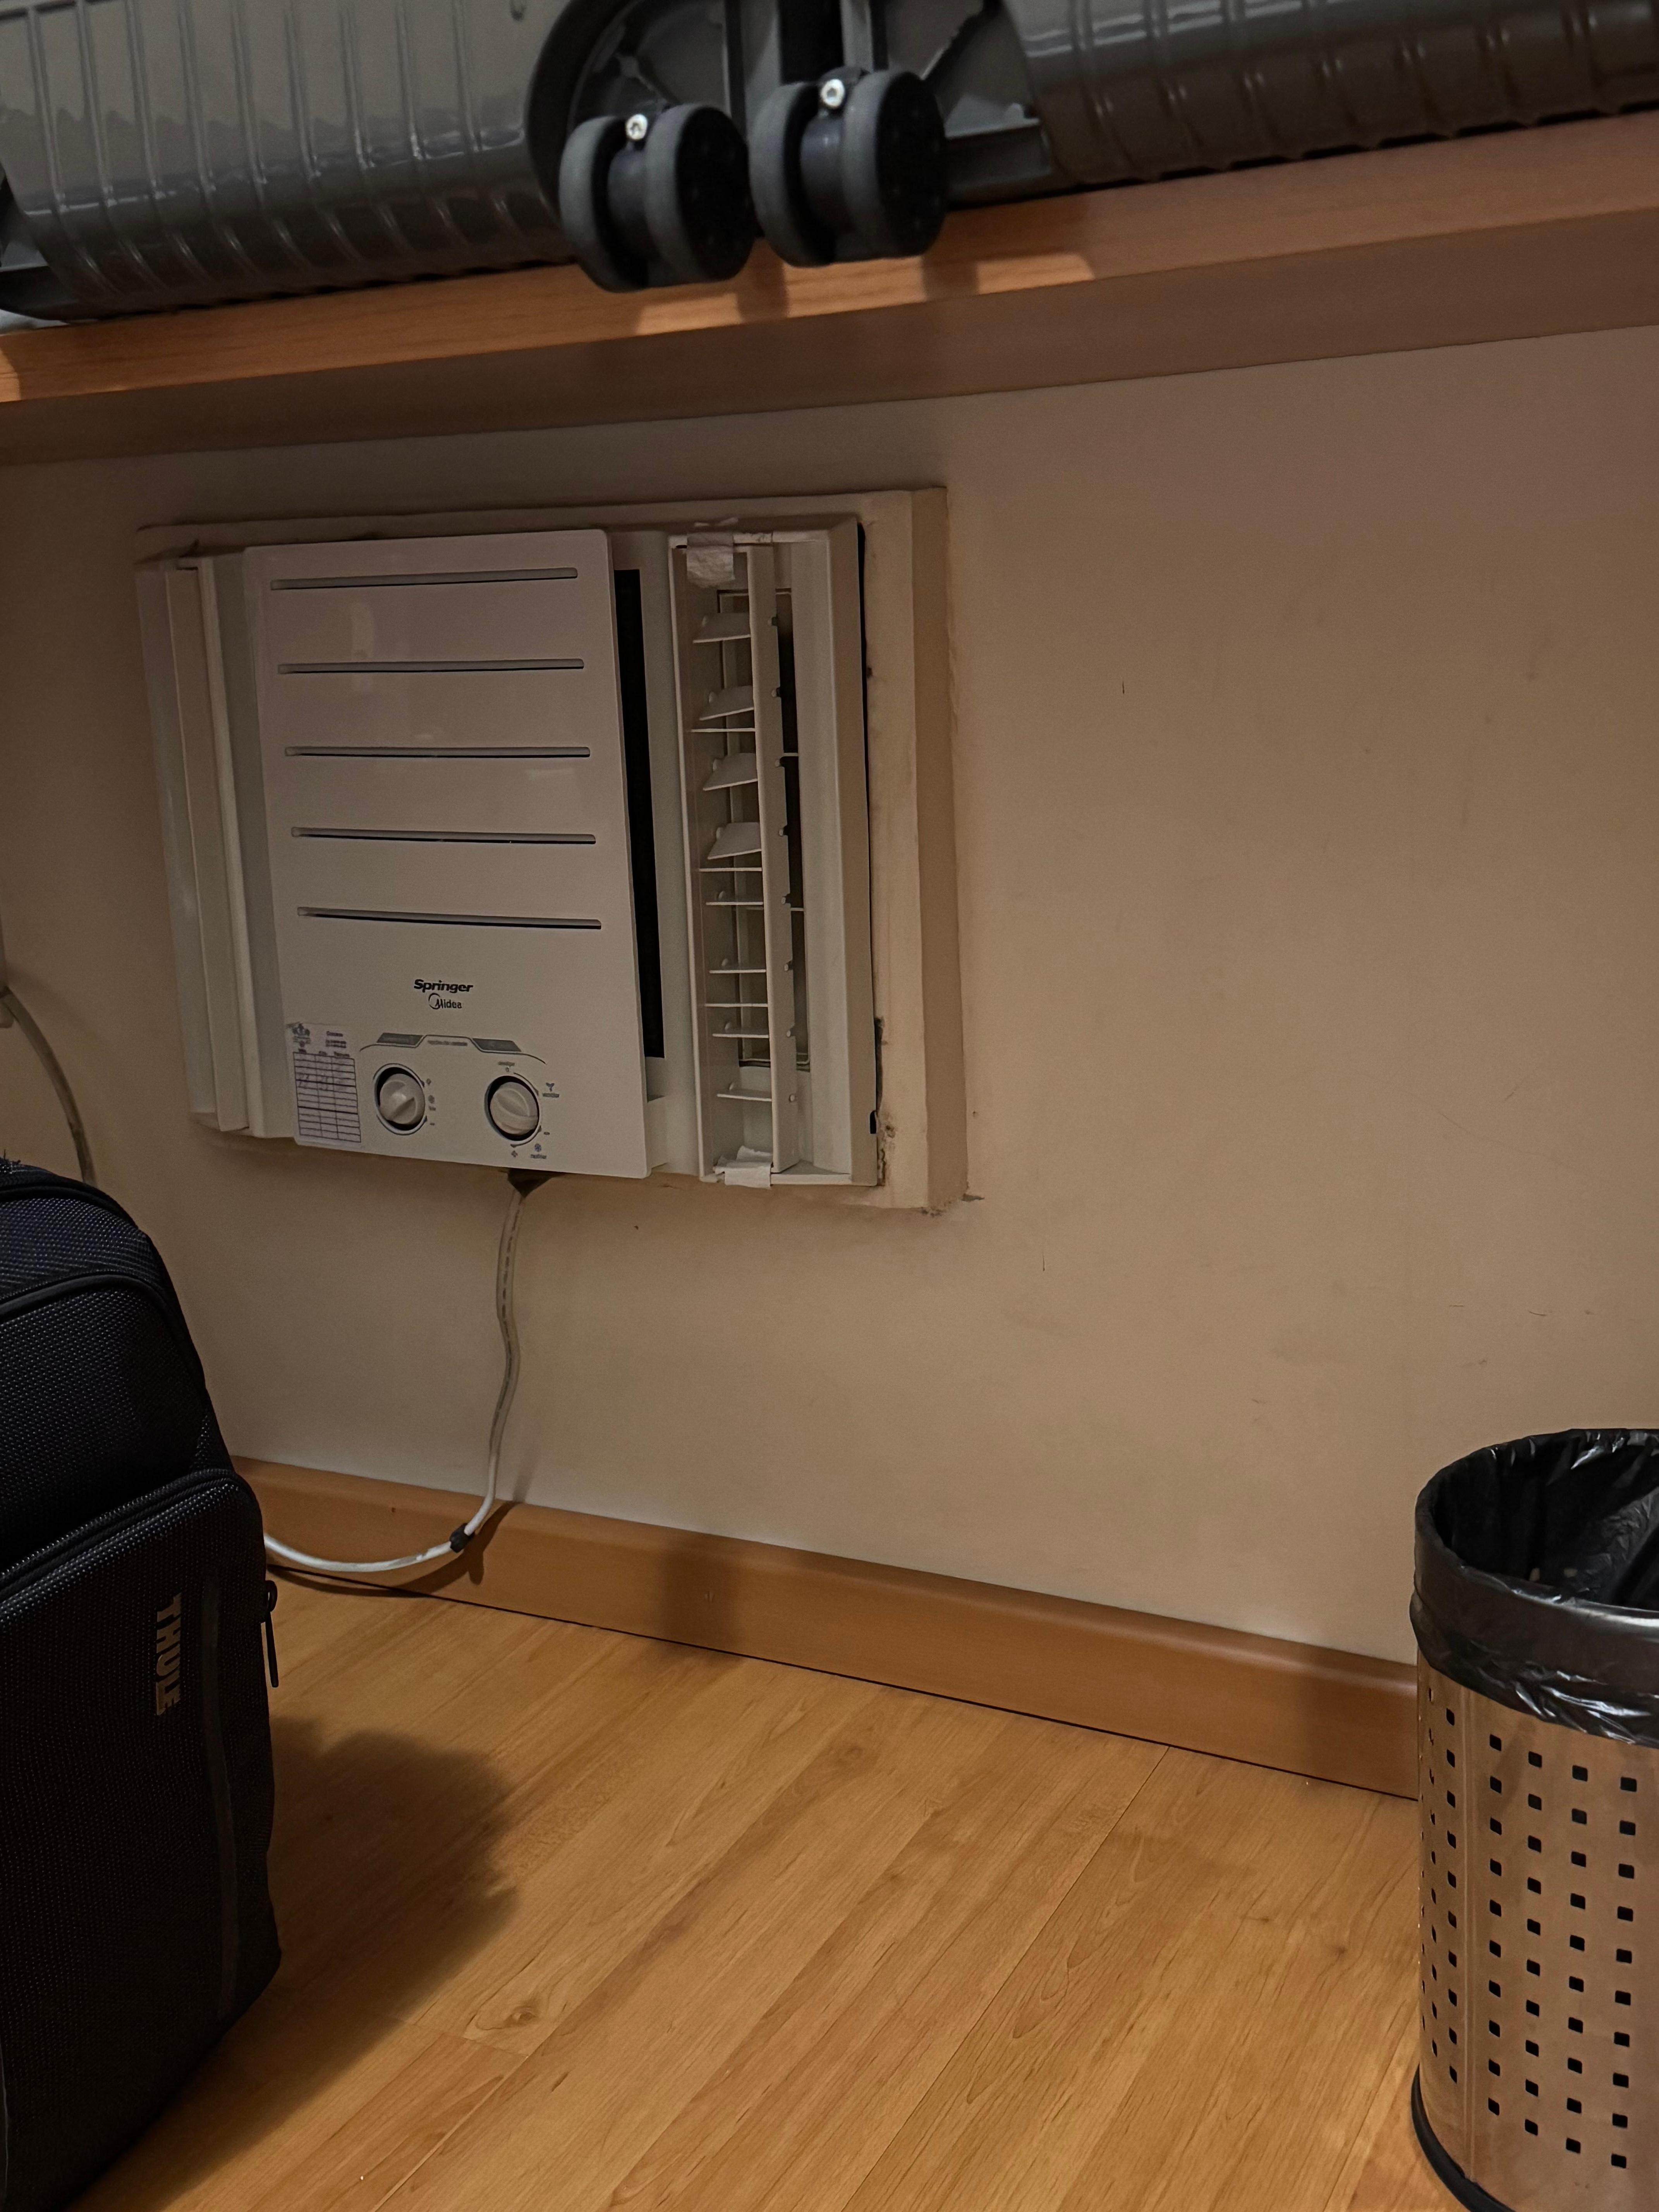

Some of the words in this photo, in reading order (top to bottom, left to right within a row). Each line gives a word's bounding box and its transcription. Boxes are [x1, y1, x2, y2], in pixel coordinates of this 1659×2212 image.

[414, 979, 474, 993] Springer
[428, 994, 462, 1010] Midea
[156, 1592, 181, 1715] THULE
